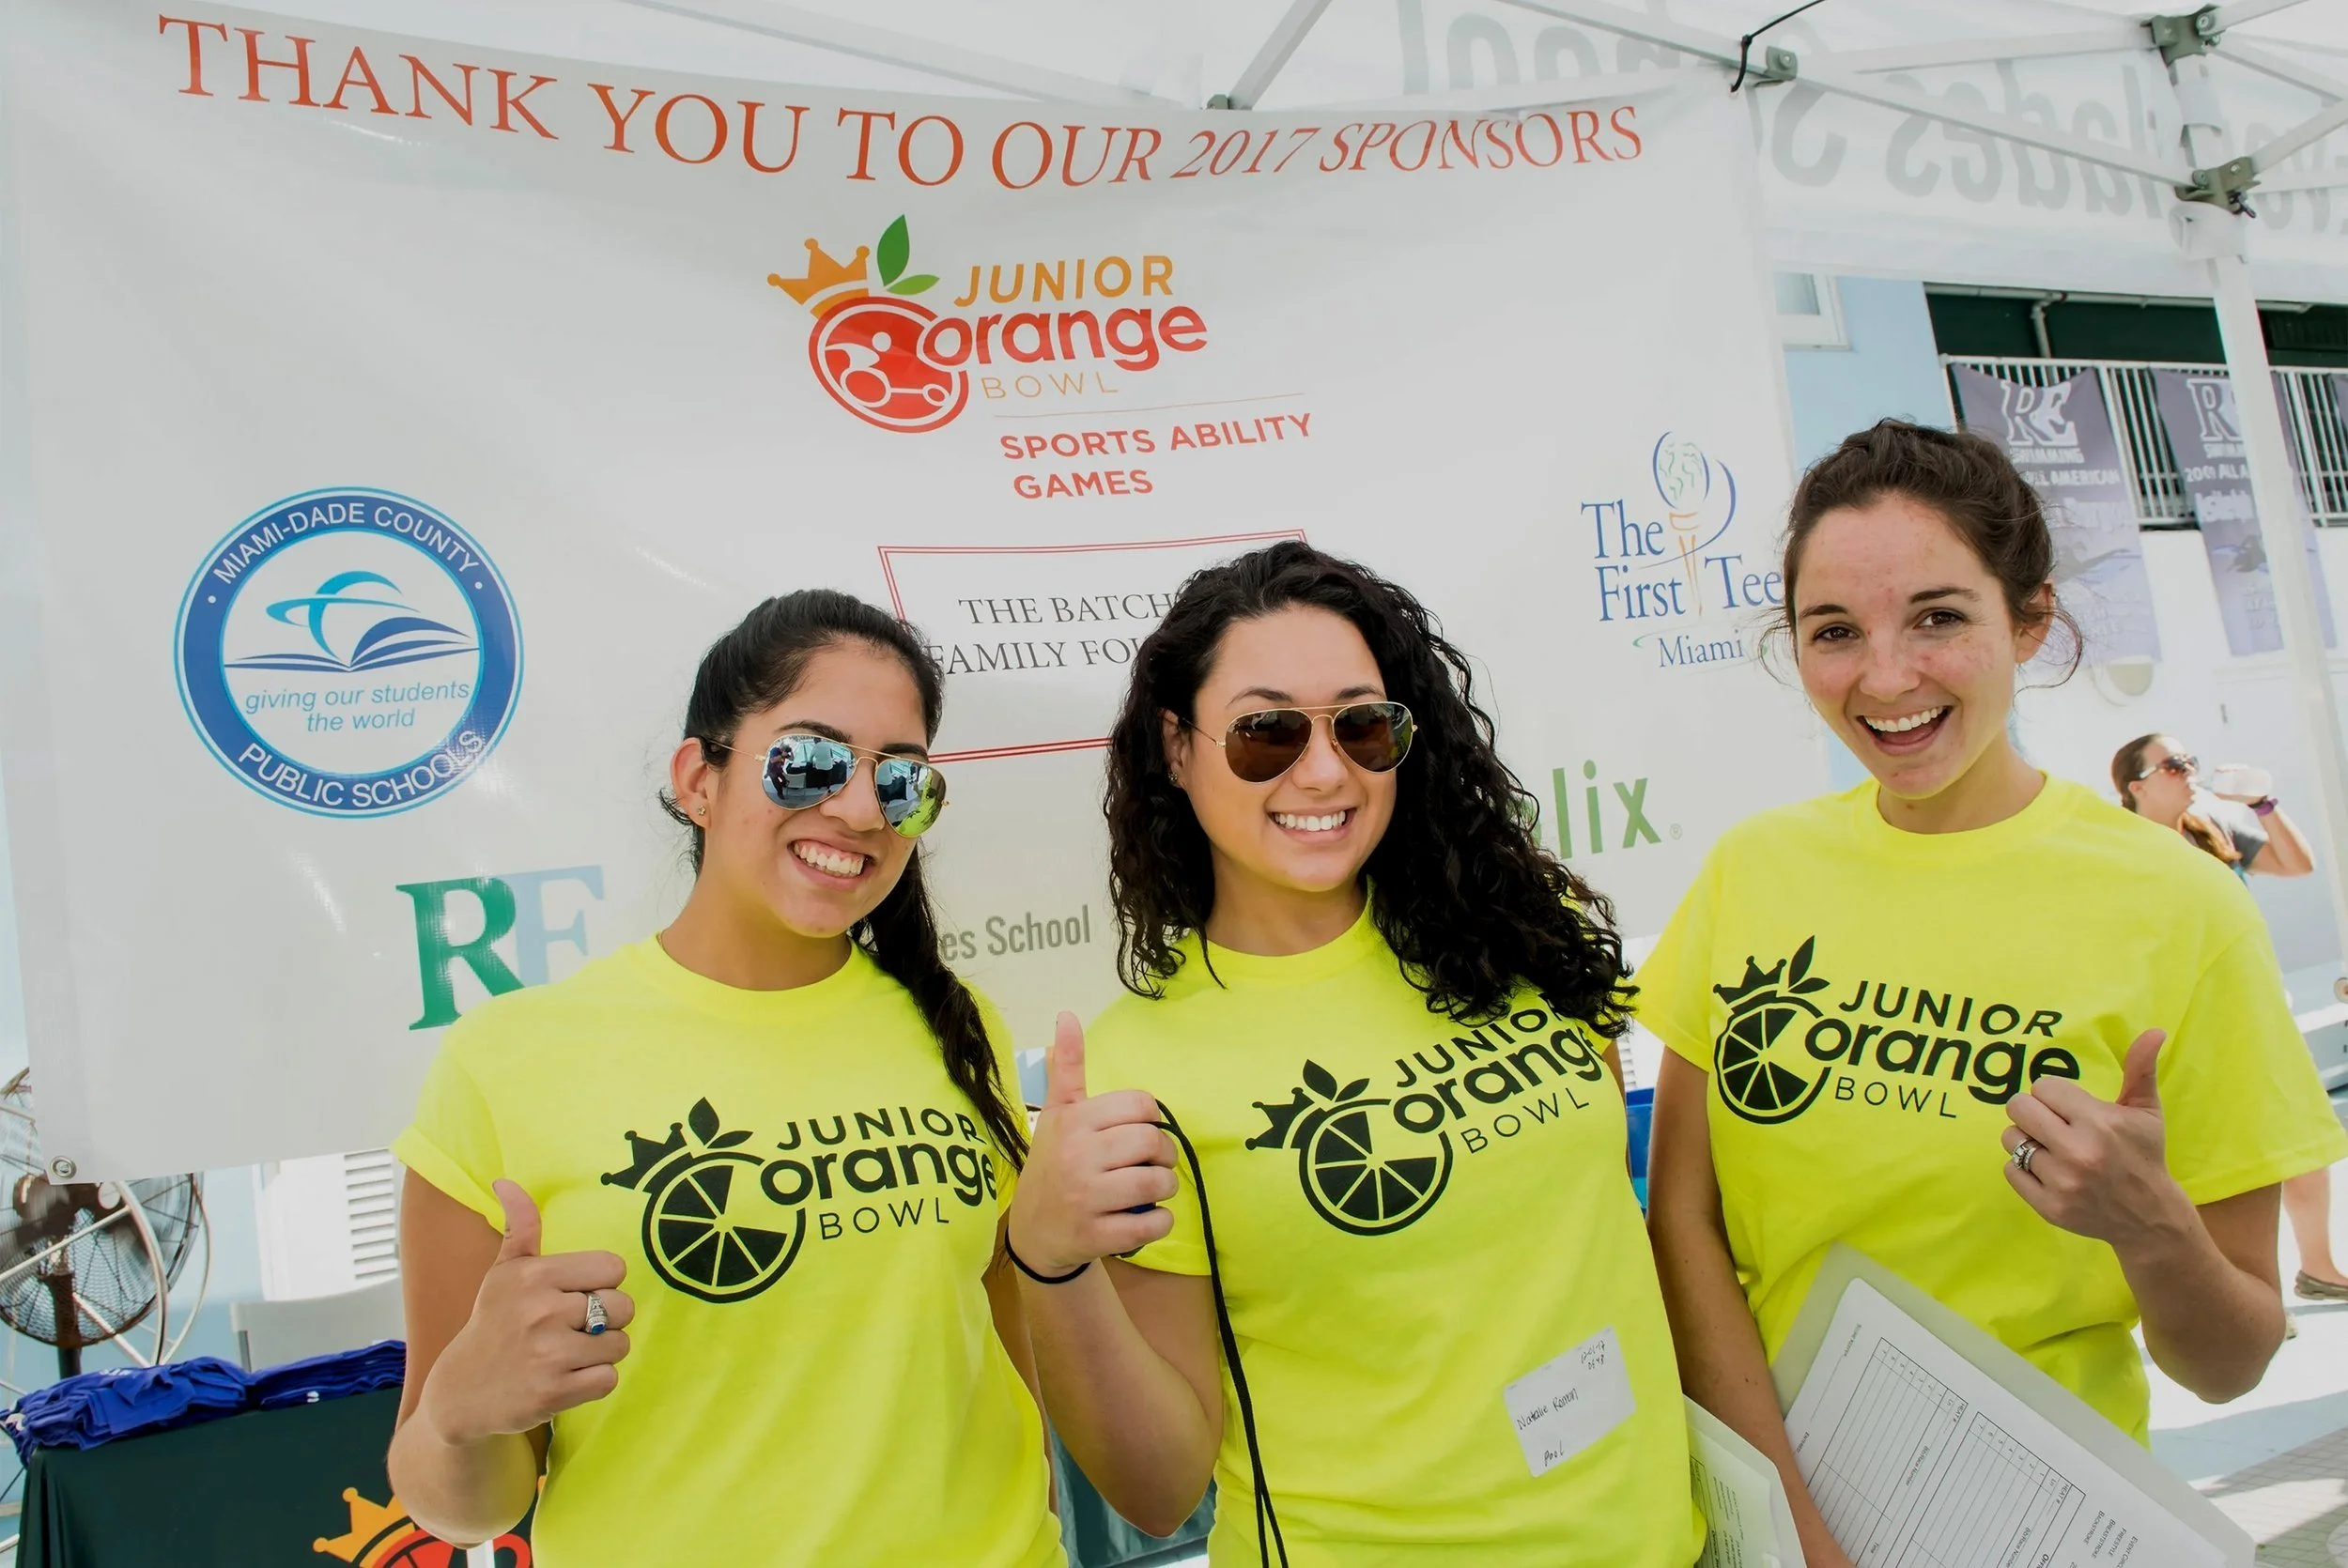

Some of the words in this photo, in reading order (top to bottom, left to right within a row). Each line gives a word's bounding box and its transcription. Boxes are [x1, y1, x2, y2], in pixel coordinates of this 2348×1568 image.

[158, 14, 561, 141] THANK
[587, 83, 811, 174] YOU
[837, 107, 965, 187] TO
[991, 121, 1163, 190] OUR
[1170, 127, 1322, 179] 2017
[1319, 105, 1644, 173] SPONSORS
[953, 254, 1175, 308] JUNIOR
[922, 305, 1209, 373] orange
[981, 372, 1120, 400] BOWL
[999, 429, 1156, 460] SPORTS
[1169, 412, 1312, 452] ABILITY
[1012, 469, 1154, 500] GAMES
[212, 502, 365, 585] MIAMI-DADE
[374, 505, 480, 573] COUNTY
[1580, 499, 1665, 559] The
[958, 597, 1043, 624] THE
[1048, 592, 1174, 623] BATCH
[1594, 564, 1687, 622] First
[1704, 554, 1784, 609] Tee
[1658, 628, 1745, 668] Miami
[245, 690, 317, 715] giving
[325, 686, 365, 706] our
[371, 680, 470, 704] students
[306, 712, 344, 732] the
[352, 708, 415, 730] world
[238, 742, 345, 807] PUBLIC
[351, 730, 484, 808] SCHOOLS
[985, 904, 1091, 956] School
[1838, 980, 2063, 1038] JUNIOR
[1804, 1017, 2080, 1105] orange
[1460, 1086, 1589, 1154] BOWL
[1834, 1076, 1957, 1119] BOWL
[777, 1105, 987, 1150] JUNIOR
[760, 1140, 997, 1207] orange
[819, 1196, 950, 1240] BOWL
